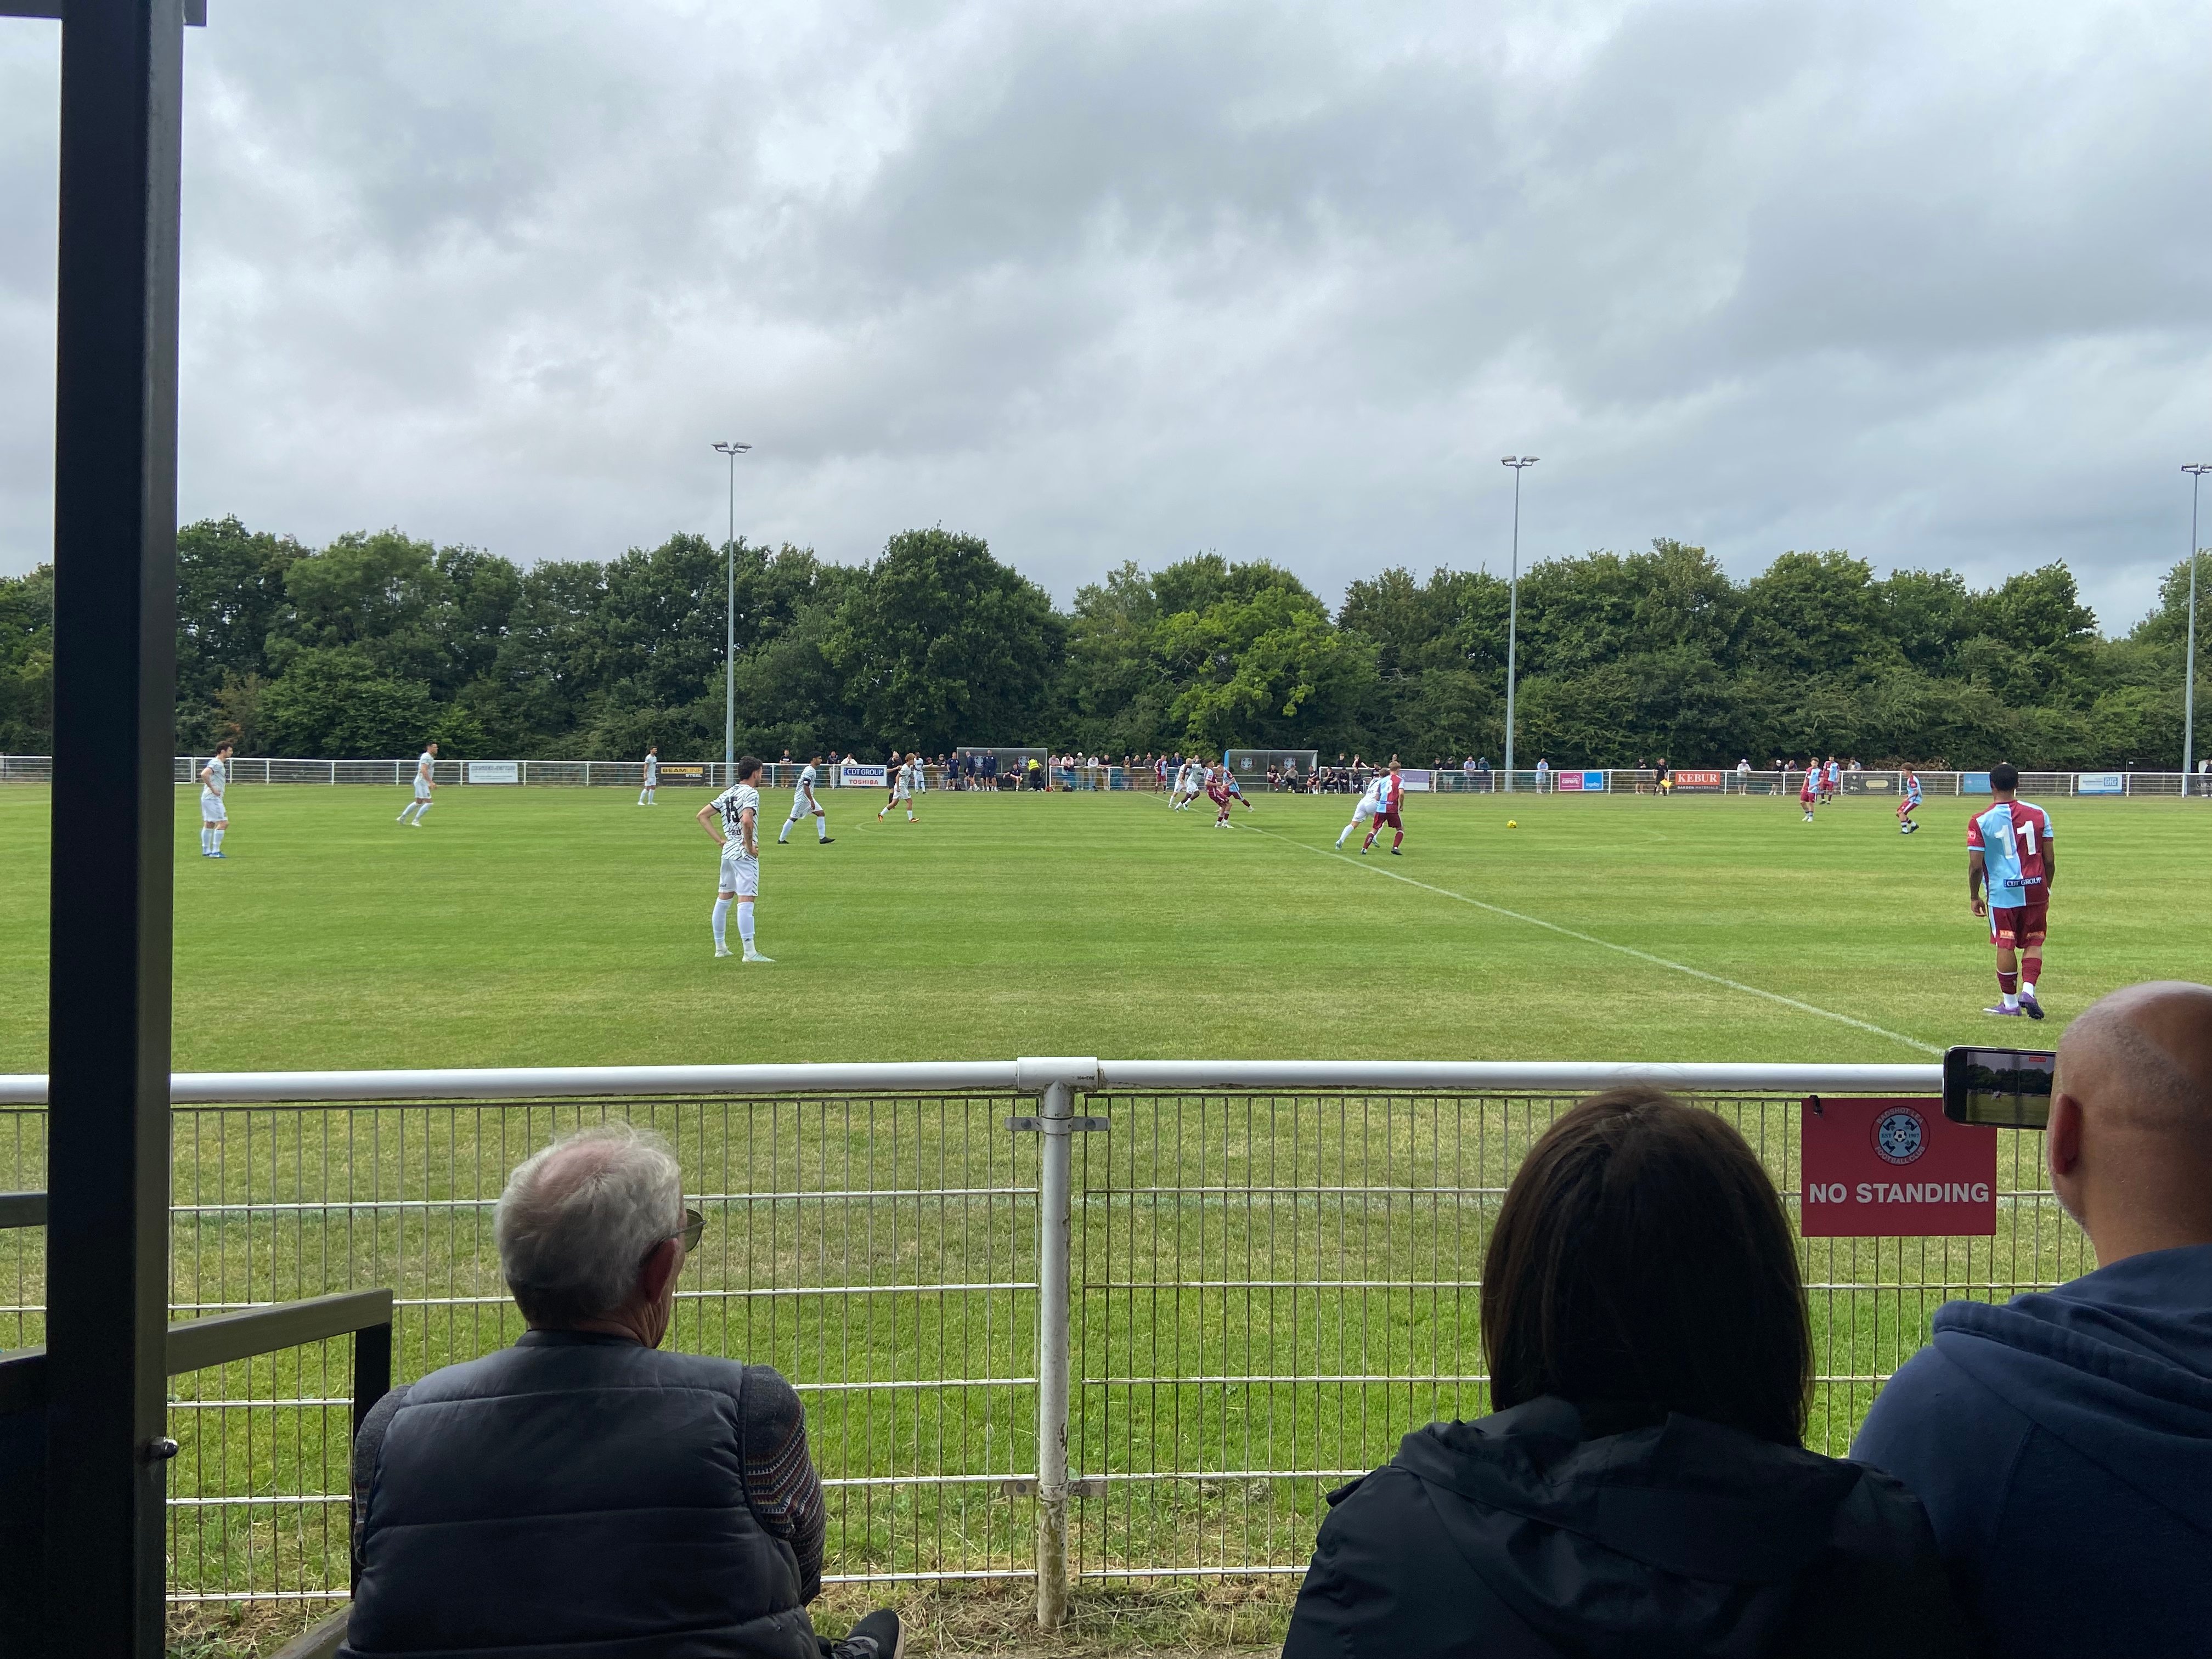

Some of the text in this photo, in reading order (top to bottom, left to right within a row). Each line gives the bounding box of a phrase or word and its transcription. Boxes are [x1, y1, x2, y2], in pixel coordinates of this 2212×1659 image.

[1386, 780, 1393, 793] 8
[1678, 774, 1718, 782] KEBUR
[724, 796, 740, 823] 15
[2021, 877, 2042, 886] GROUP
[1876, 1107, 1924, 1124] BADSHOT LEA
[1875, 1146, 1926, 1164] FOOTBALL CLUB
[1810, 1183, 1989, 1204] NO STANDING
